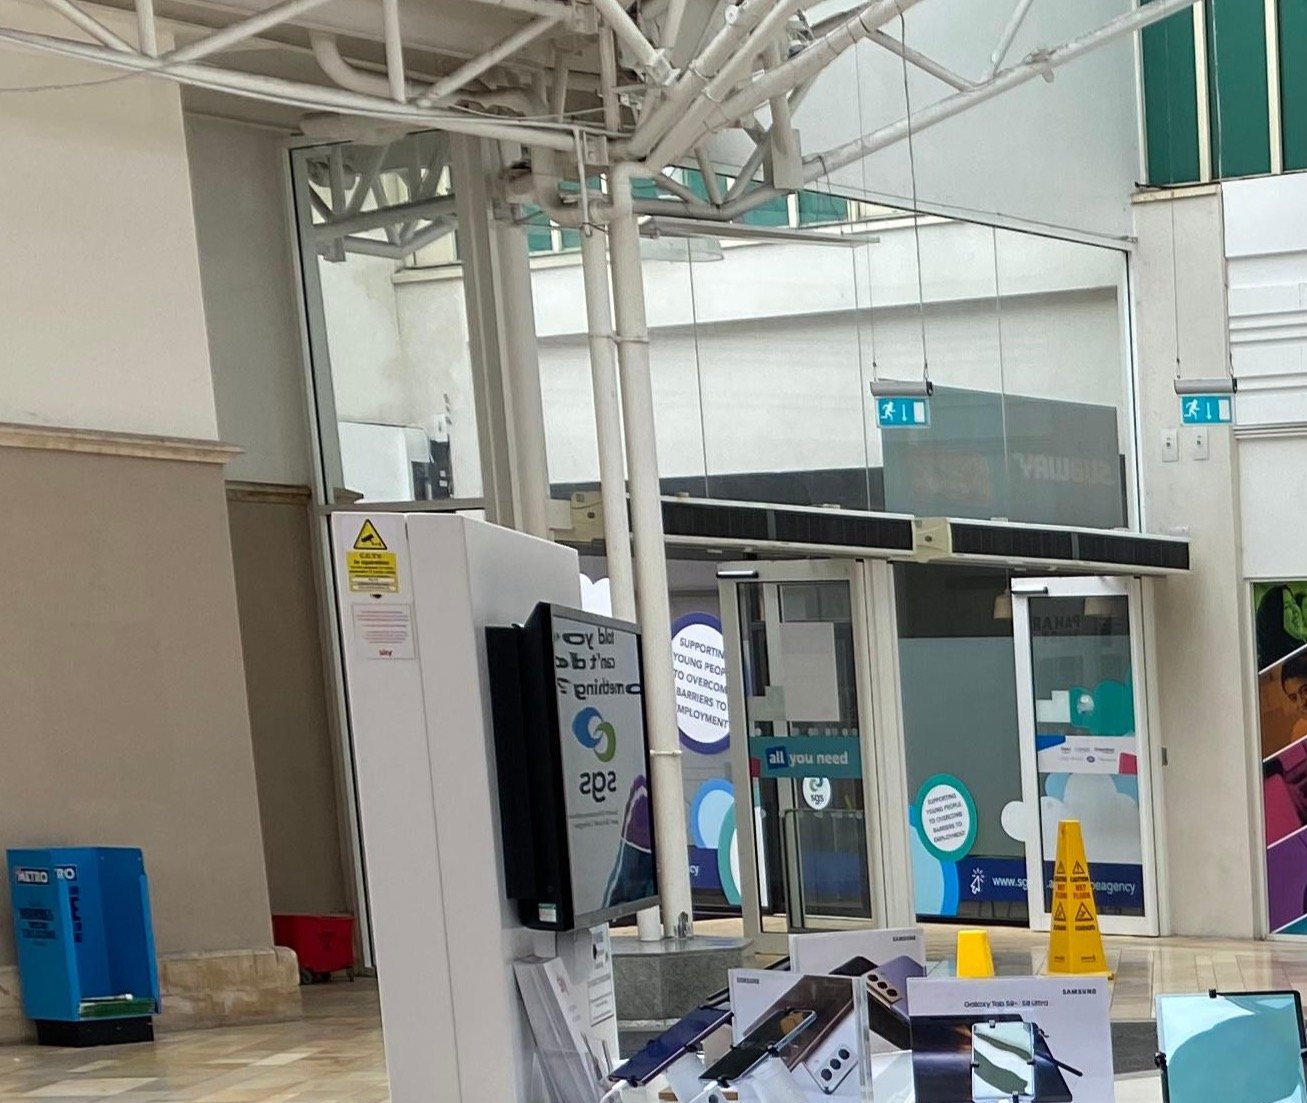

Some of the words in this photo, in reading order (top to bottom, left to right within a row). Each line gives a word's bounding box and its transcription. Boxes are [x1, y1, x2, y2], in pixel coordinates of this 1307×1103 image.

[673, 652, 702, 671] YOUNG
[676, 687, 714, 707] BARRIERS
[716, 699, 727, 712] TO
[769, 750, 785, 764] all
[789, 752, 813, 768] you
[816, 752, 848, 764] need
[810, 794, 824, 805] sgs
